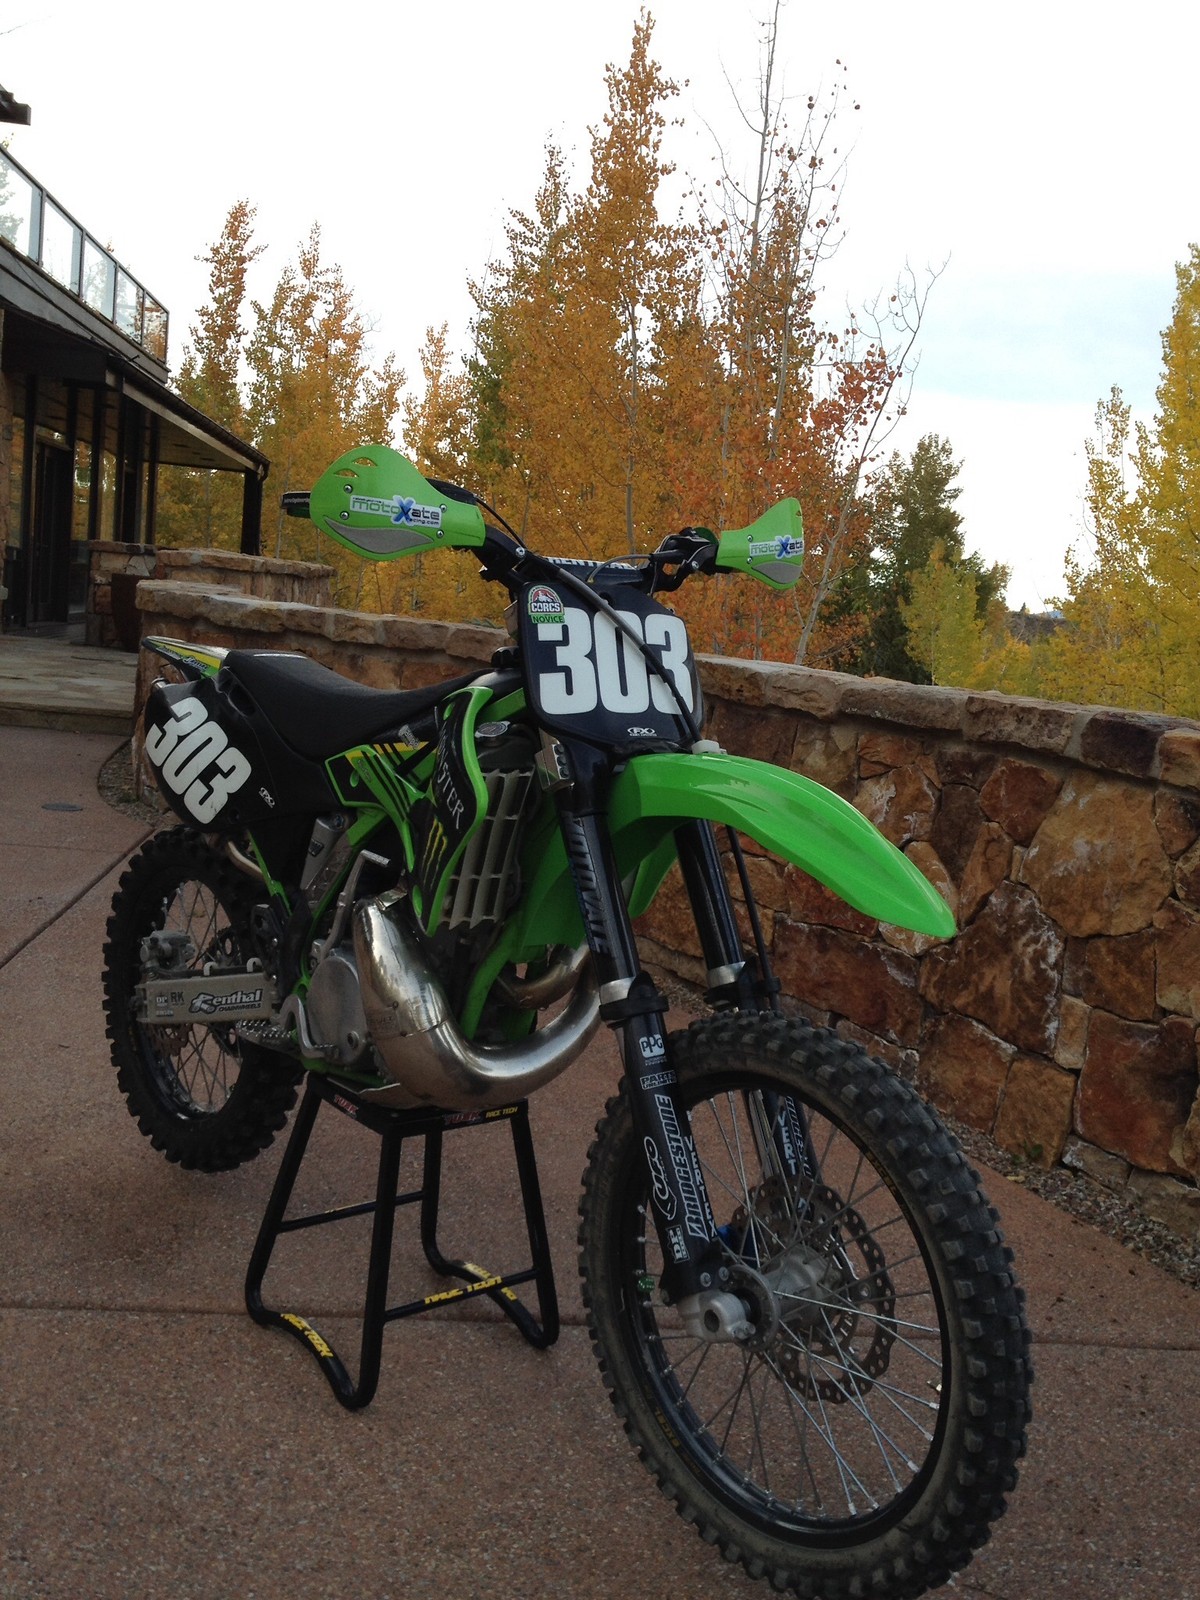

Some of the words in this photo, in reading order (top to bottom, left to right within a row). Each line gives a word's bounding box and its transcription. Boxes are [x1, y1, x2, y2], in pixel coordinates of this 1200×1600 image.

[531, 602, 561, 613] CORCS
[533, 614, 564, 624] NOVICE
[537, 607, 694, 715] 303
[145, 697, 252, 824] 303
[189, 988, 263, 1014] Renthal
[641, 1036, 664, 1053] PPG
[655, 1094, 710, 1242] BRIDGESTONE
[684, 1135, 718, 1238] VERTEX
